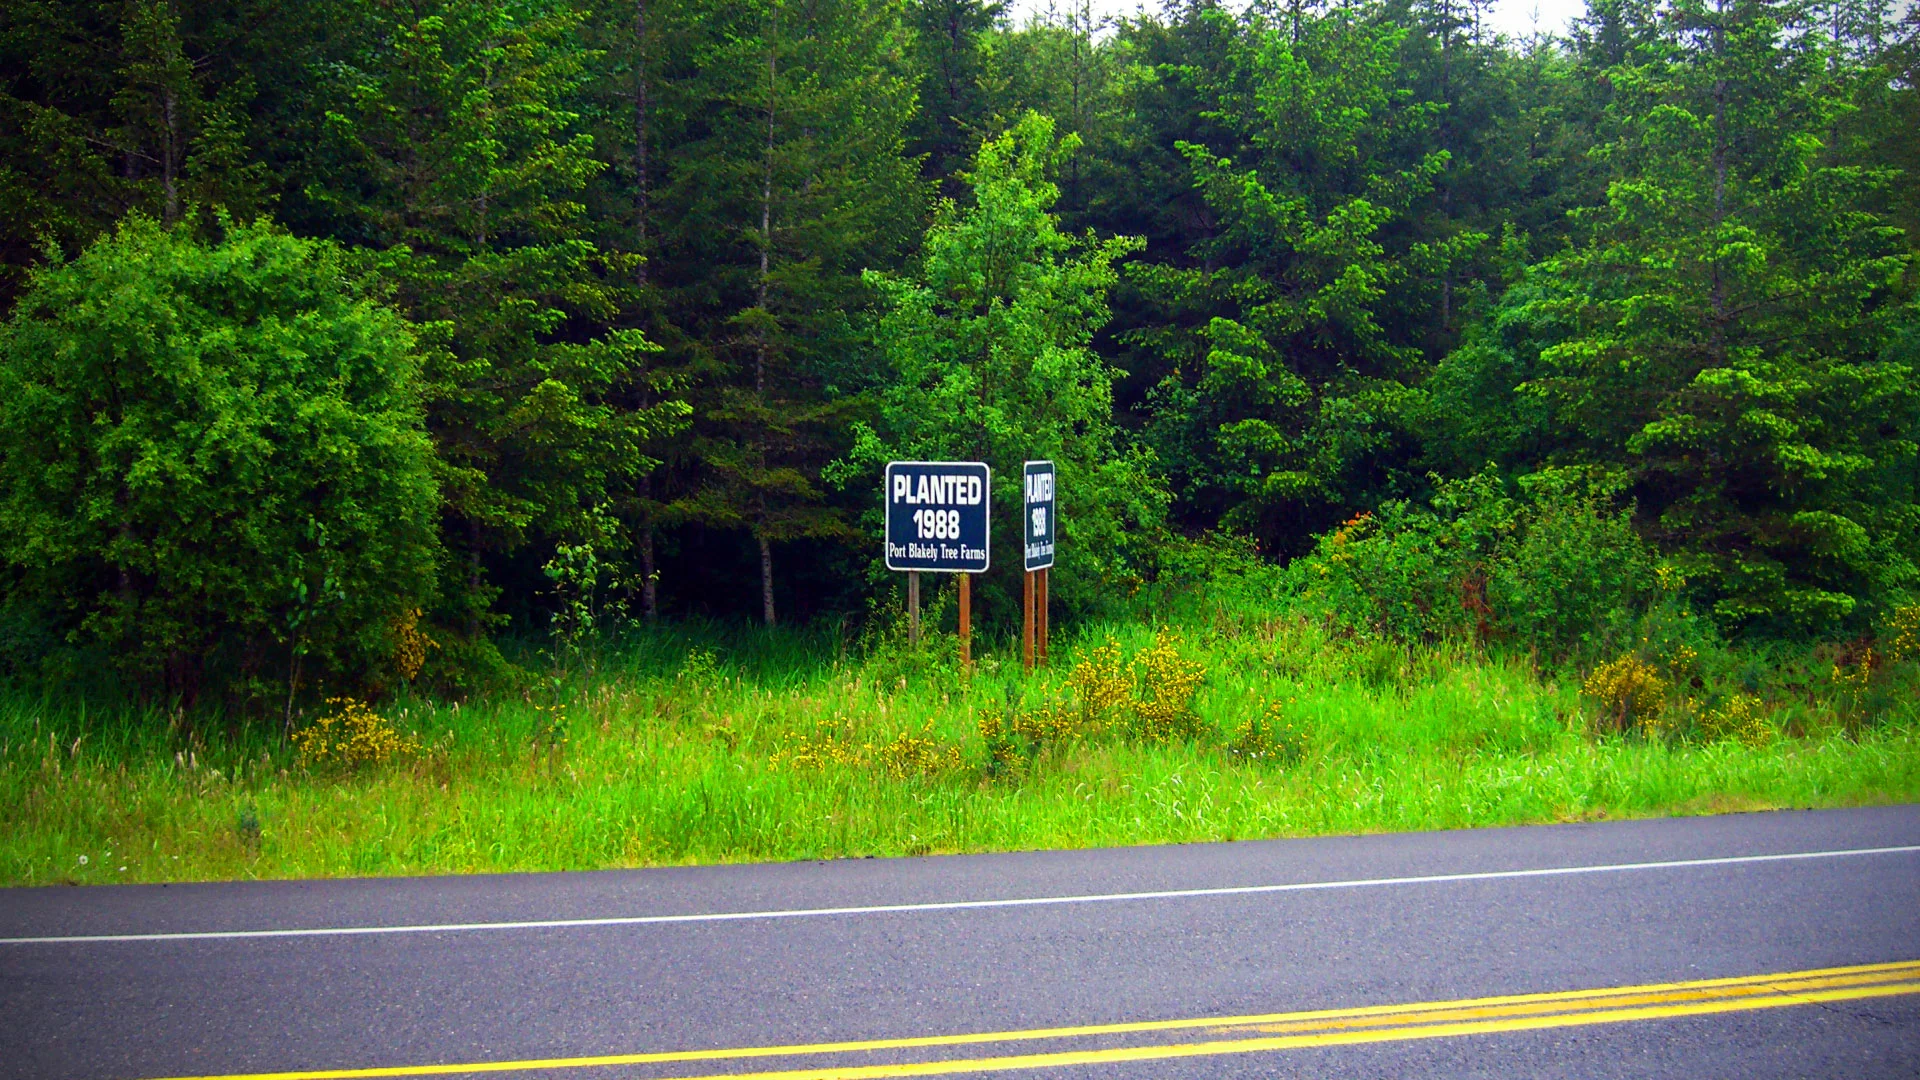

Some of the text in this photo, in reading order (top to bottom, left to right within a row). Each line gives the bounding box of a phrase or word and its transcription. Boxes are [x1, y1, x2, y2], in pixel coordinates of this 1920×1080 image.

[894, 474, 982, 505] PLANTED
[913, 509, 960, 540] 1988
[889, 542, 985, 562] Port Blakely Tree Farms
